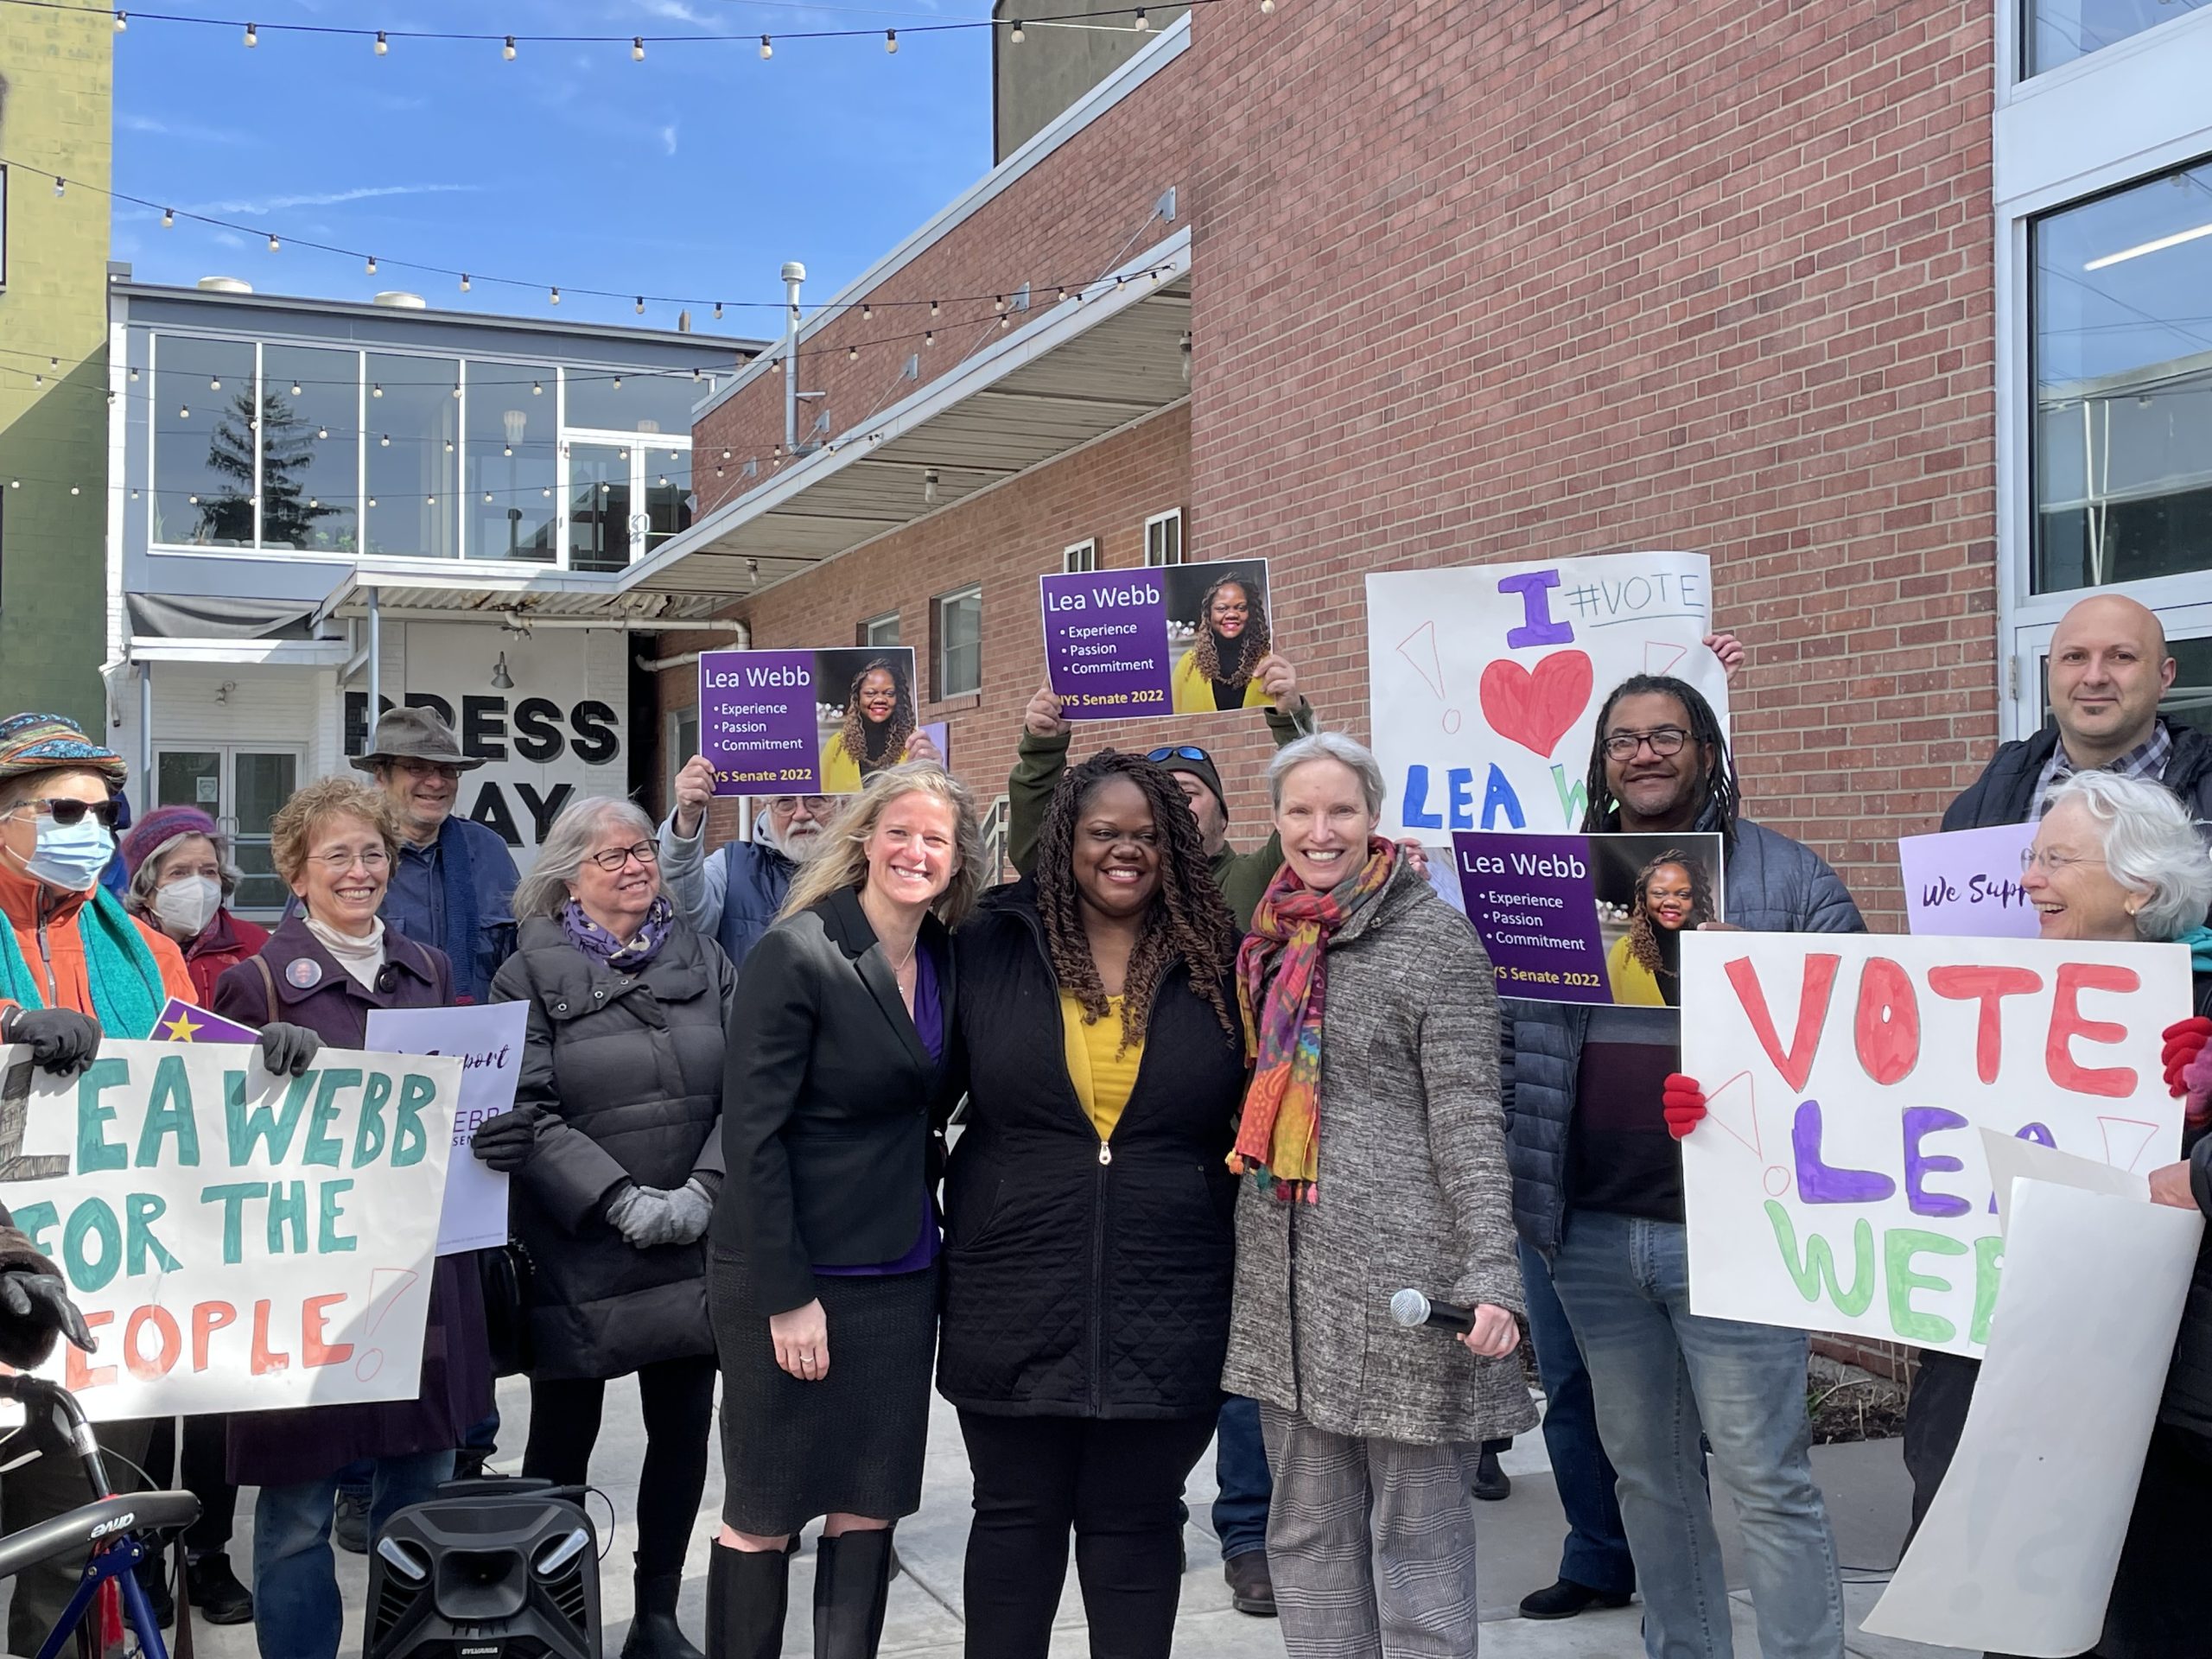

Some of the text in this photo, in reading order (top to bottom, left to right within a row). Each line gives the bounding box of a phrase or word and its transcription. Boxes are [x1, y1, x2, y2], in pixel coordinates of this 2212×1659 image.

[1048, 583, 1160, 612] Lea Webb
[1564, 573, 1705, 619] #VOTE
[1068, 623, 1138, 640] Experience
[1070, 643, 1117, 657] Passion
[705, 664, 811, 689] Lea Webb
[1071, 658, 1154, 675] Commitment
[1082, 692, 1128, 706] Senate
[1131, 690, 1165, 704] 2022
[721, 702, 788, 716] Experience
[721, 721, 767, 734] Passion
[721, 738, 804, 752] Commitment
[713, 767, 813, 783] YS Senate 2022
[1402, 763, 1526, 830] LEA
[469, 781, 575, 848] AY
[1462, 851, 1586, 880] Lea Webb
[1489, 891, 1563, 908] Experience
[1923, 876, 1961, 906] We
[1492, 912, 1543, 927] Passion
[1496, 931, 1586, 951] Commitment
[1511, 967, 1560, 985] Senate
[1563, 972, 1601, 988] 2022
[1724, 953, 2141, 1098] VOTE
[0, 1055, 436, 1182] LEA WEBB
[10, 1179, 358, 1294] FOR THE
